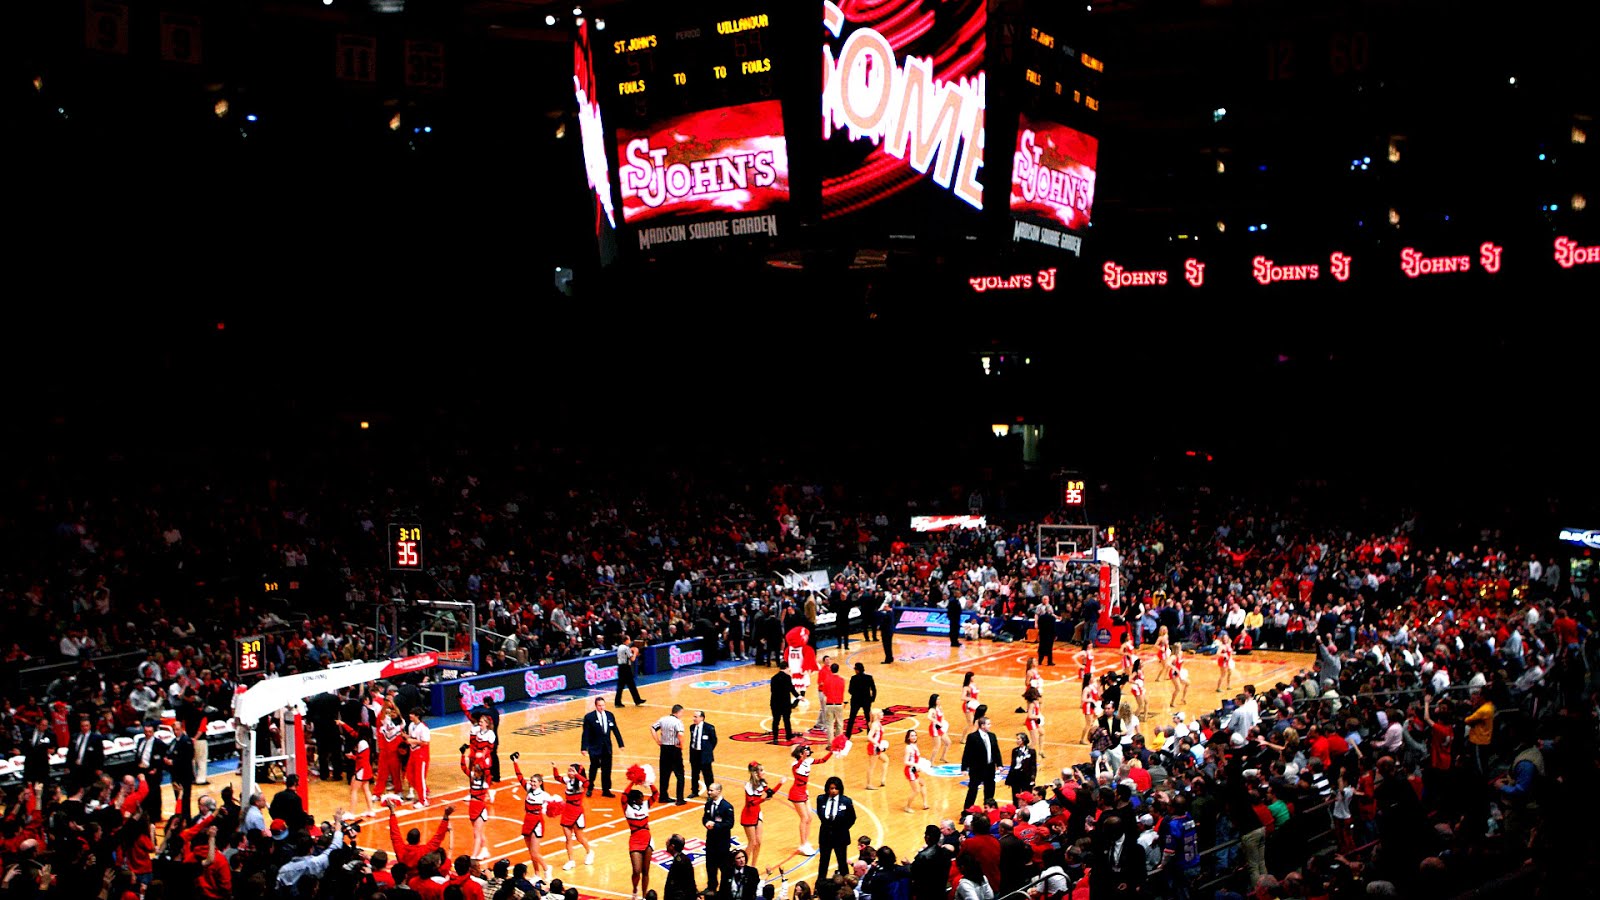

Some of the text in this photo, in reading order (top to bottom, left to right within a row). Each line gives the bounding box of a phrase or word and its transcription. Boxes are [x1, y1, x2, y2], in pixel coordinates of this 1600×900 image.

[717, 14, 769, 35] VILLANOVA
[713, 66, 727, 79] TO
[742, 58, 771, 75] FOULS
[673, 72, 686, 85] TO
[619, 80, 645, 95] FOULS
[823, 27, 986, 210] OME
[638, 215, 778, 250] MADISON SQUARE GARDEN
[1066, 490, 1081, 503] 35
[400, 527, 421, 541] 3:17
[398, 542, 418, 565] 35
[242, 640, 261, 654] 3:17
[242, 654, 258, 669] 35
